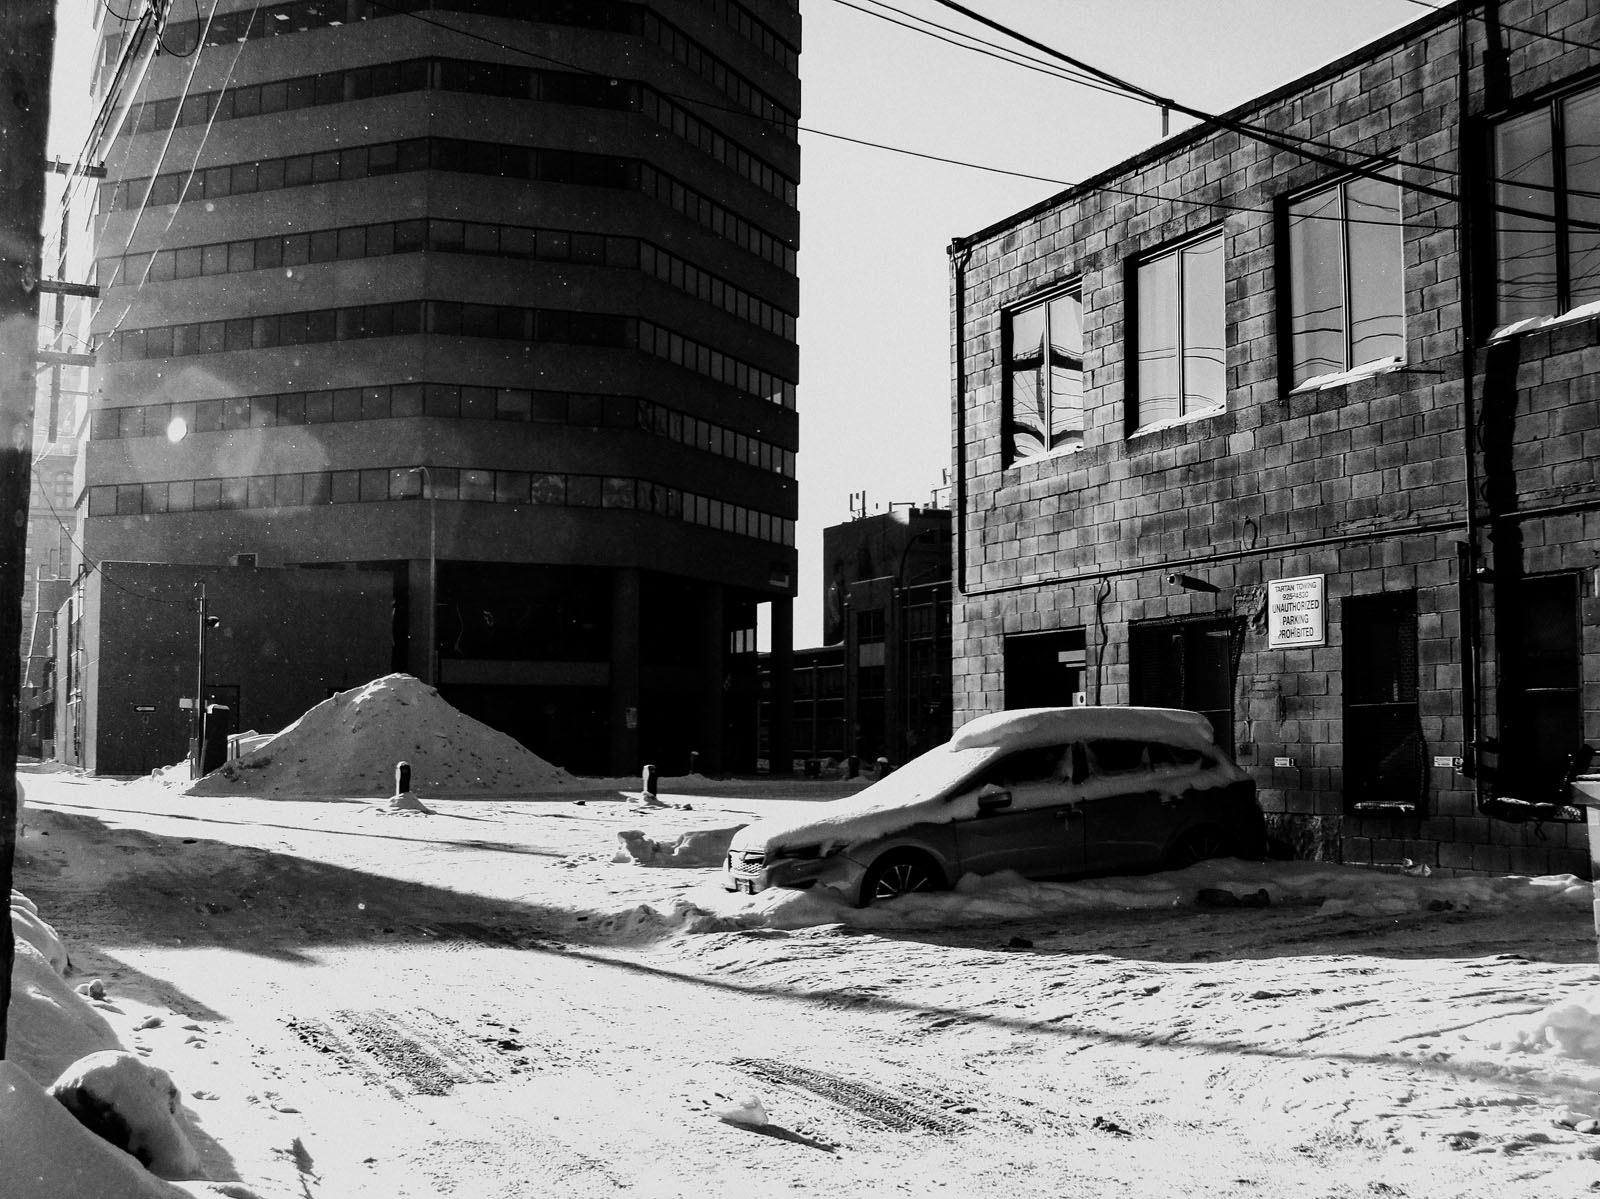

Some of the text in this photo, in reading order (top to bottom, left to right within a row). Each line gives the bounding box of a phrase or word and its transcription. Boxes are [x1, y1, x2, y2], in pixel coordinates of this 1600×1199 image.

[1275, 584, 1295, 592] TARTAN
[1272, 600, 1320, 613] UNAUTHORIZED
[1282, 614, 1309, 625] PARKING
